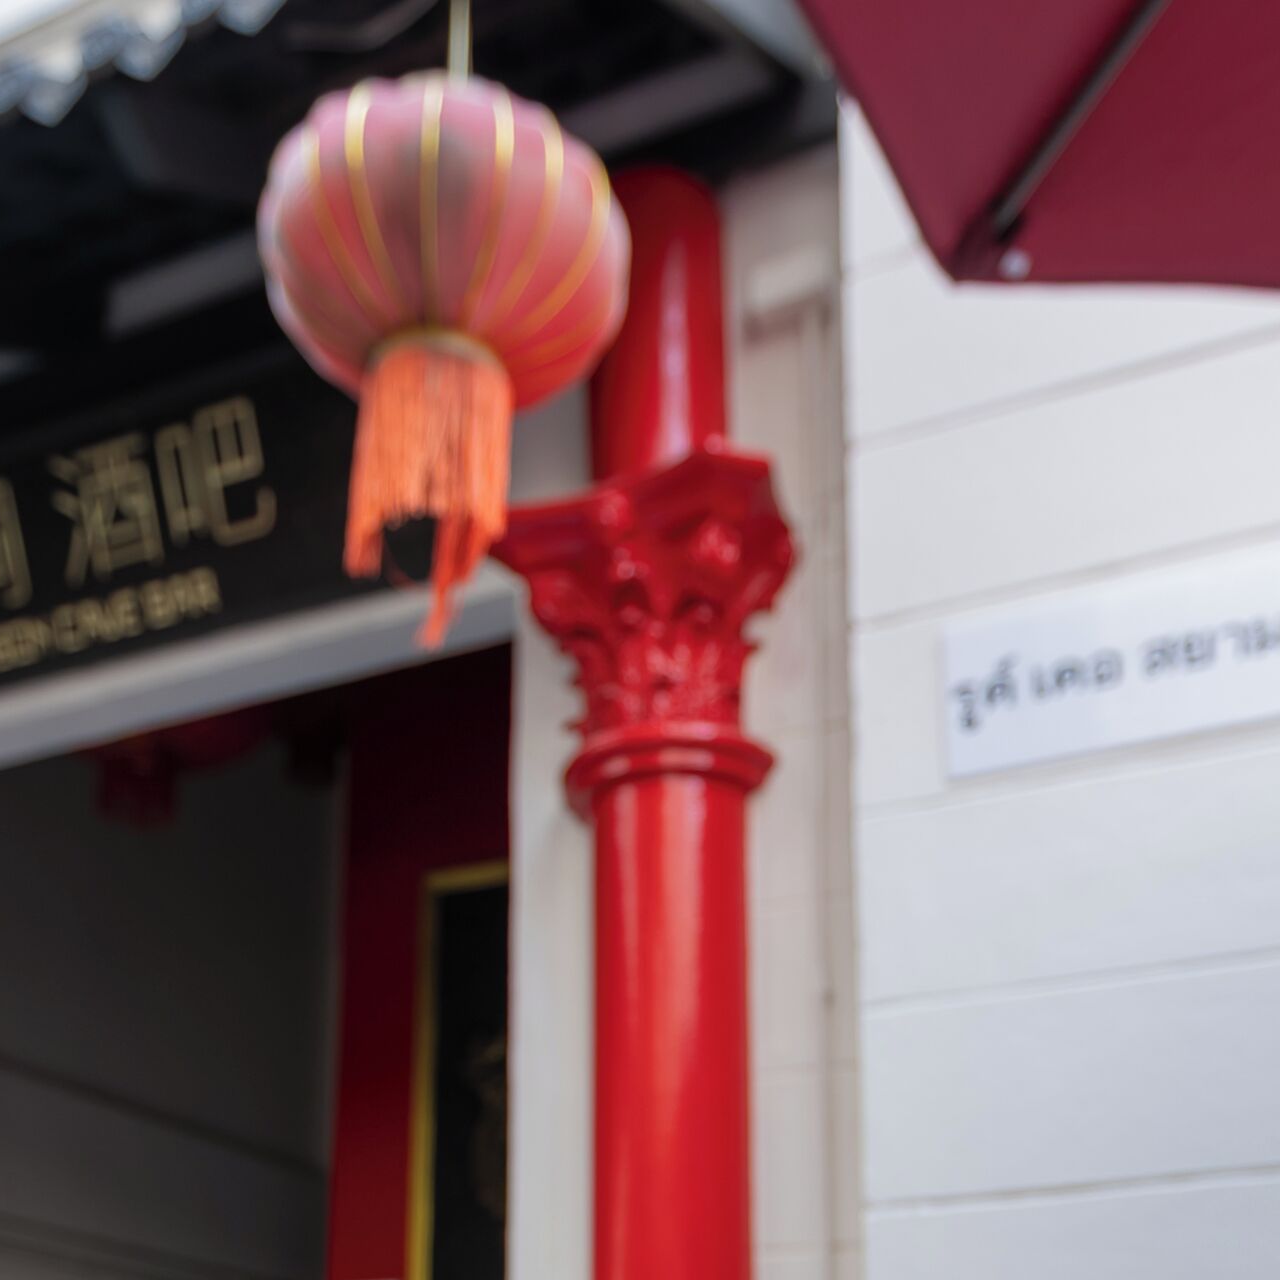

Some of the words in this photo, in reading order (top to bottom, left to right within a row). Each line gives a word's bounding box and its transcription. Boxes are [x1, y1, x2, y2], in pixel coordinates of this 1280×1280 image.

[48, 396, 276, 585] 酒吧
[51, 588, 144, 653] CAVE
[142, 566, 222, 629] BAR
